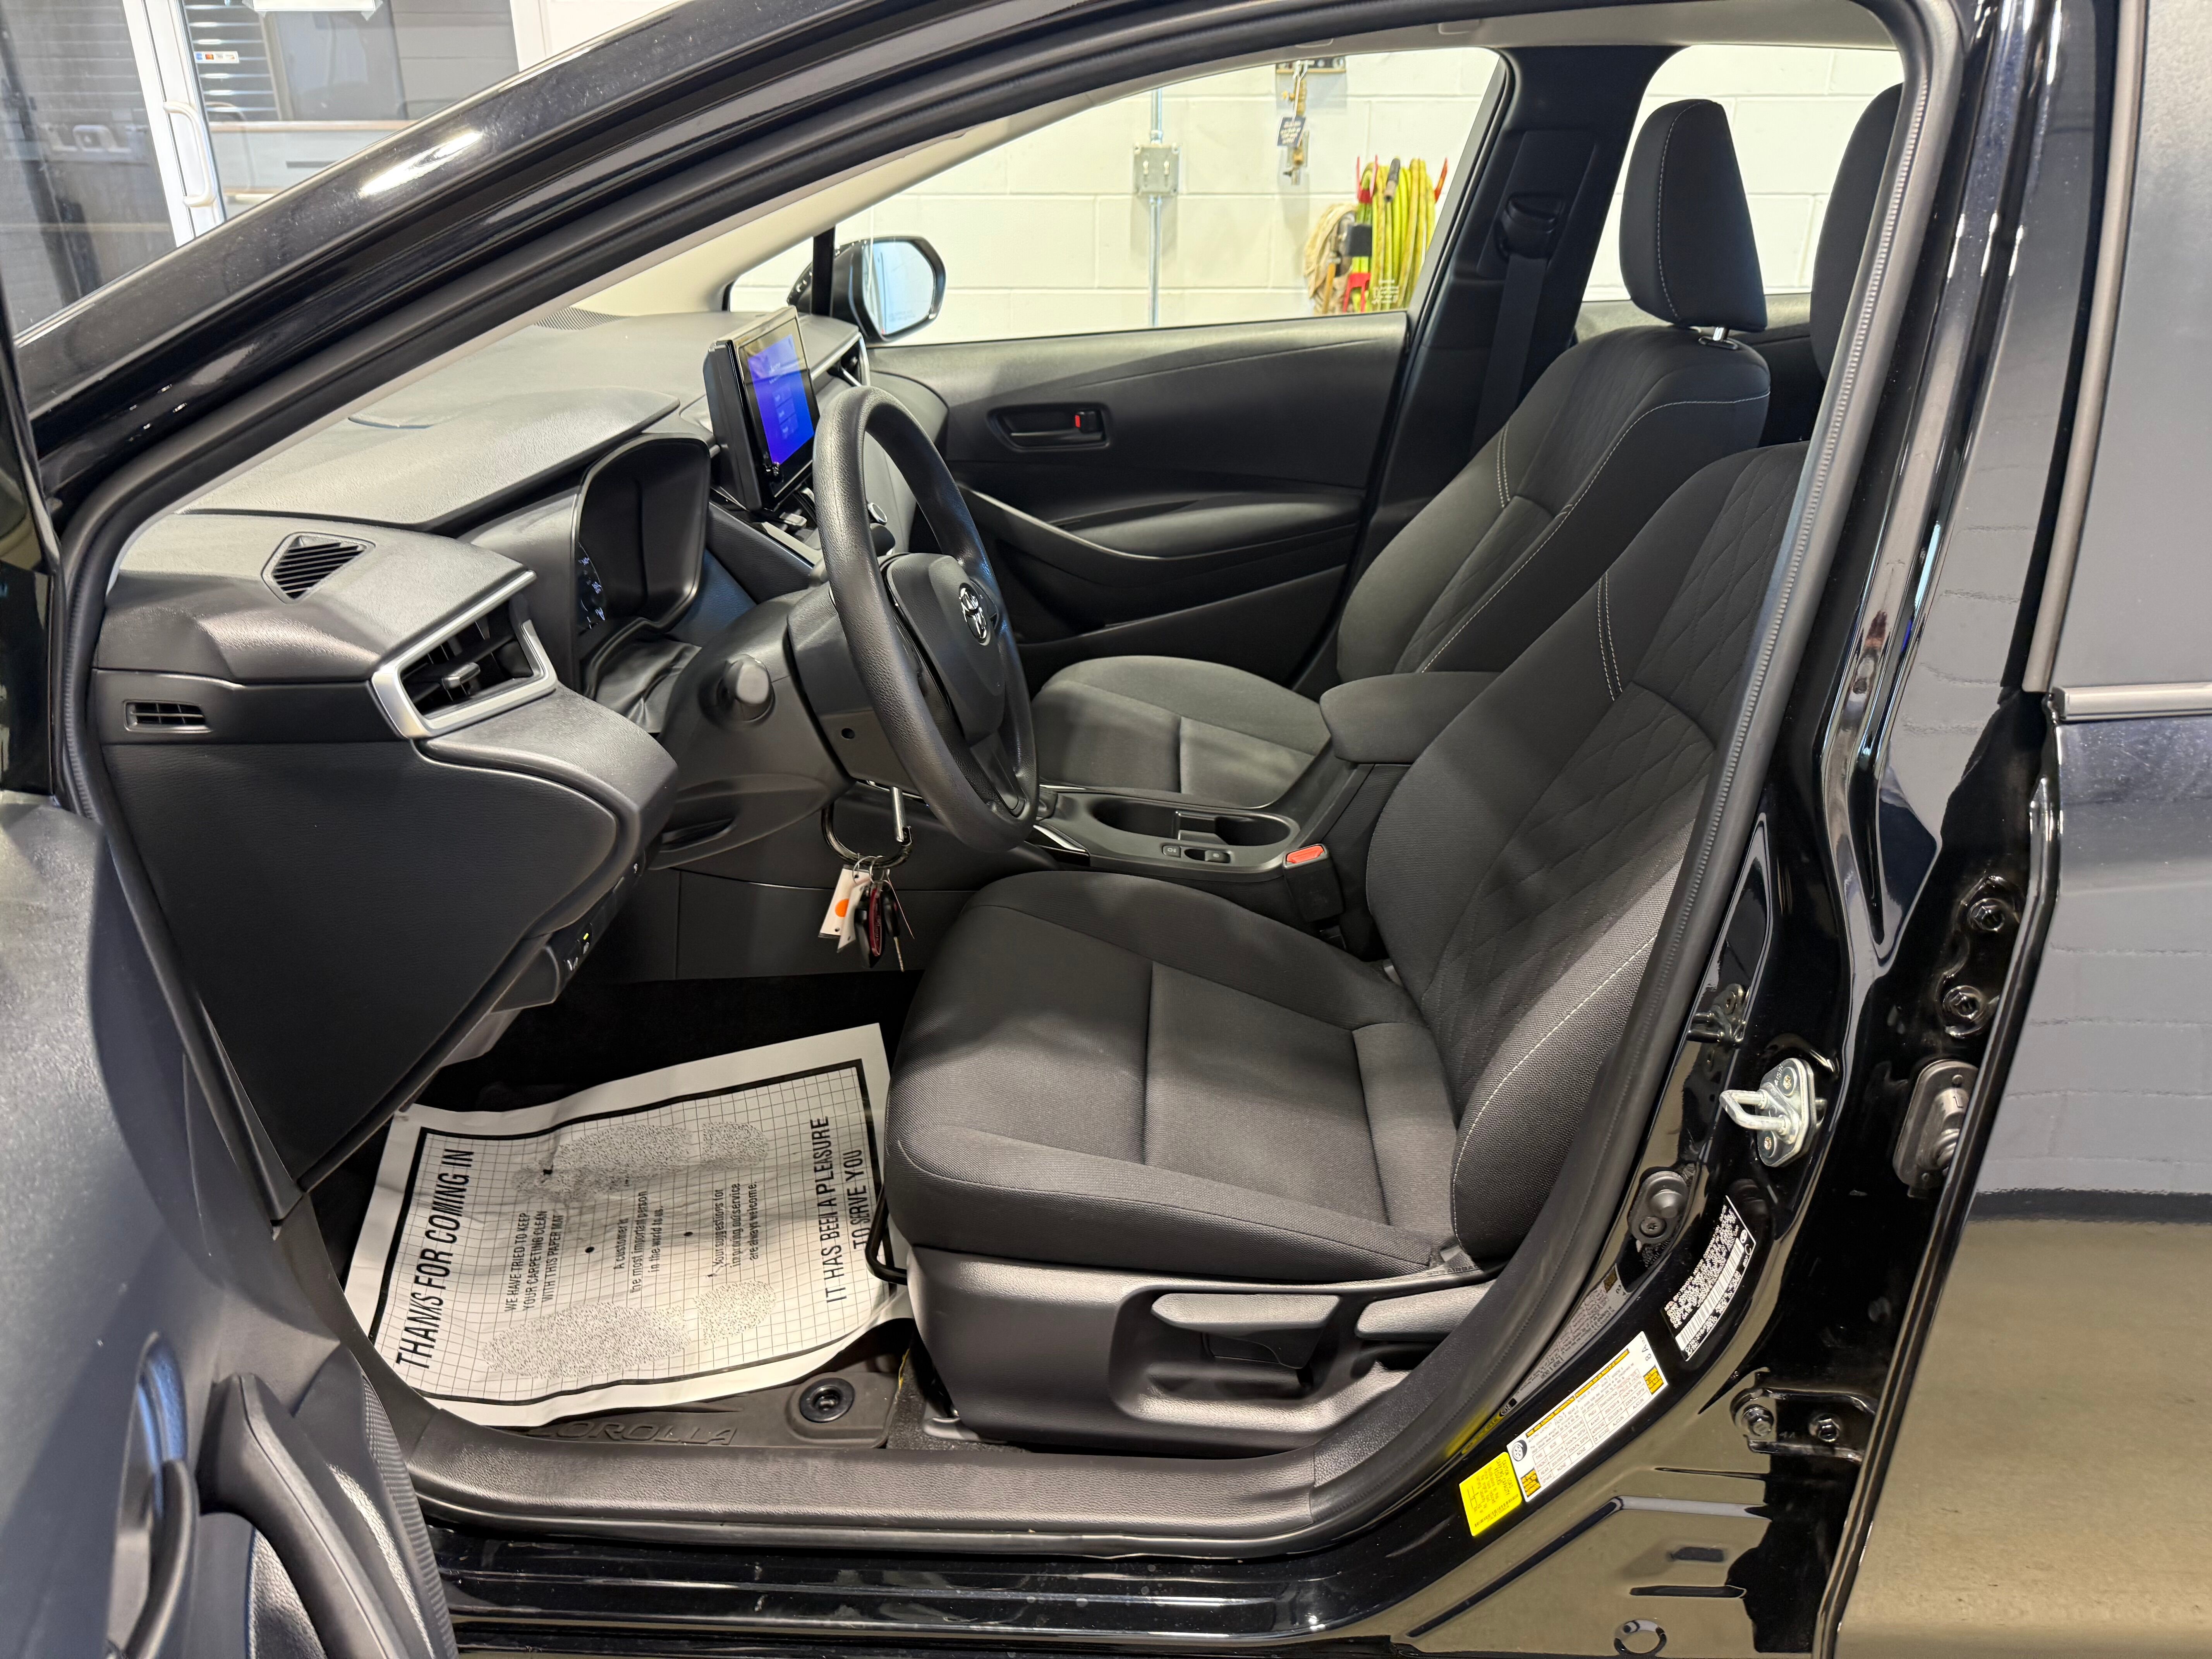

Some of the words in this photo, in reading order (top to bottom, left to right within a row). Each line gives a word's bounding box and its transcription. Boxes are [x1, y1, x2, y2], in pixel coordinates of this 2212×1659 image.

[441, 1149, 474, 1167] IN
[810, 1116, 836, 1195] PLEASURE
[842, 1149, 864, 1182] YOU
[712, 1189, 723, 1201] for
[817, 1197, 837, 1207] A
[847, 1185, 871, 1225] SERVE
[425, 1173, 470, 1243] COMING
[516, 1212, 530, 1232] KEEP
[533, 1211, 548, 1235] CLEAN
[515, 1234, 527, 1245] TO
[547, 1232, 562, 1256] PAPER
[851, 1227, 871, 1249] TO
[511, 1247, 525, 1272] TRIED
[527, 1236, 544, 1285] CARPETING
[632, 1254, 643, 1277] most
[649, 1248, 660, 1262] the
[821, 1245, 845, 1280] HAS
[414, 1248, 453, 1290] FOR
[545, 1257, 558, 1278] THIS
[648, 1264, 660, 1273] in
[507, 1273, 522, 1296] HAVE
[542, 1279, 555, 1302] WITH
[825, 1287, 847, 1303] IT
[504, 1297, 518, 1312] WE
[523, 1286, 538, 1311] YOUR
[396, 1292, 444, 1369] THANKS
